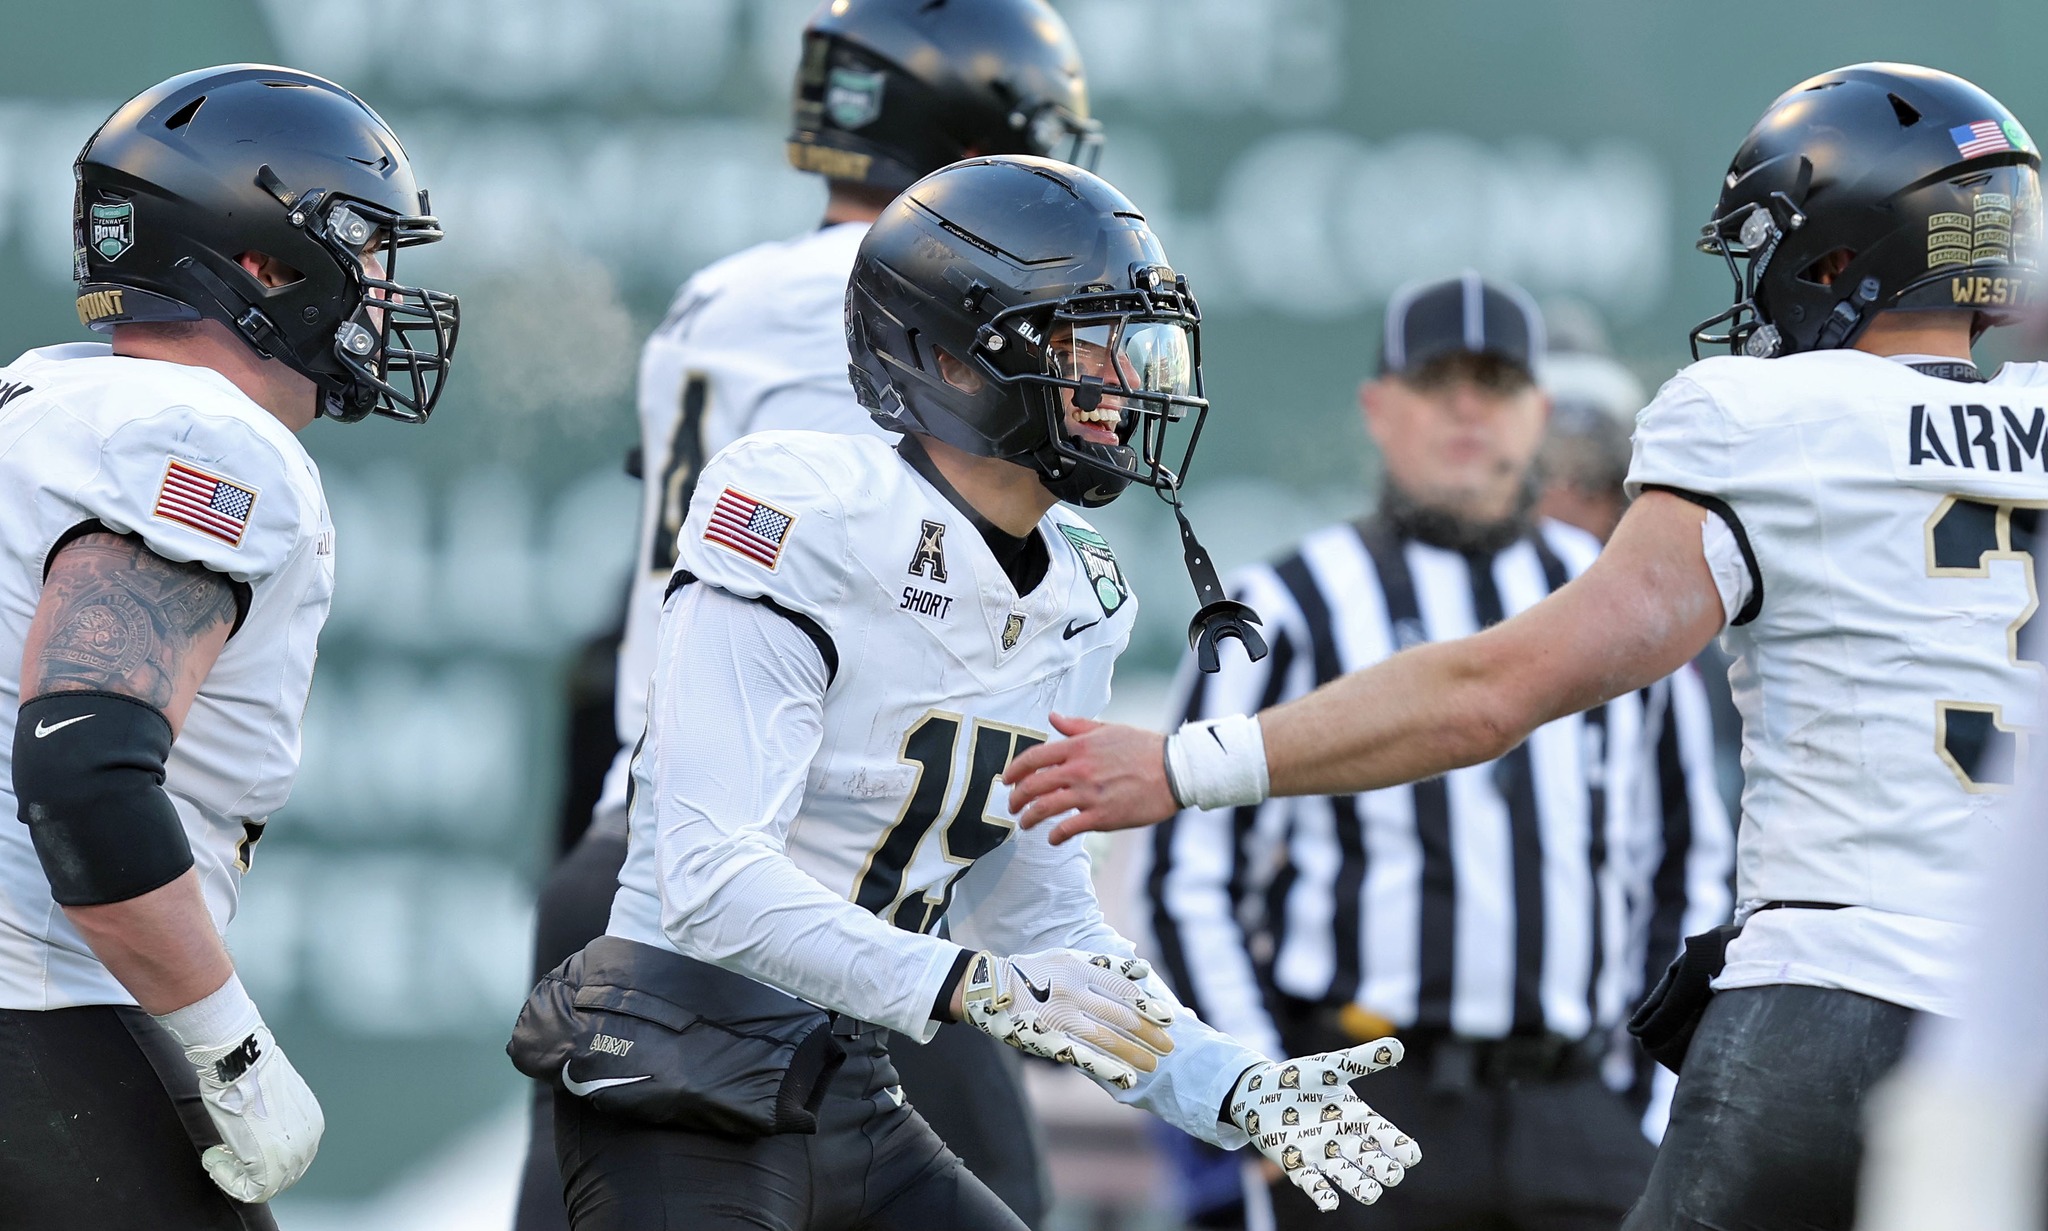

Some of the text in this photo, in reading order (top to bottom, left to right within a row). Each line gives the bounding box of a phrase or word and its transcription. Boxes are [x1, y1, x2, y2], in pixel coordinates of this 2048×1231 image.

[94, 224, 129, 244] BOWL
[1951, 276, 2022, 305] WEST
[900, 586, 953, 619] SHORT
[849, 708, 1049, 935] 15
[590, 1033, 634, 1057] ARMY
[215, 1033, 261, 1083] NIKE
[1259, 1093, 1282, 1105] ARMY
[1296, 1092, 1324, 1103] ARMY
[1297, 1126, 1323, 1139] ARMY
[1335, 1122, 1371, 1136] ARMY
[1258, 1131, 1288, 1150] ARMY
